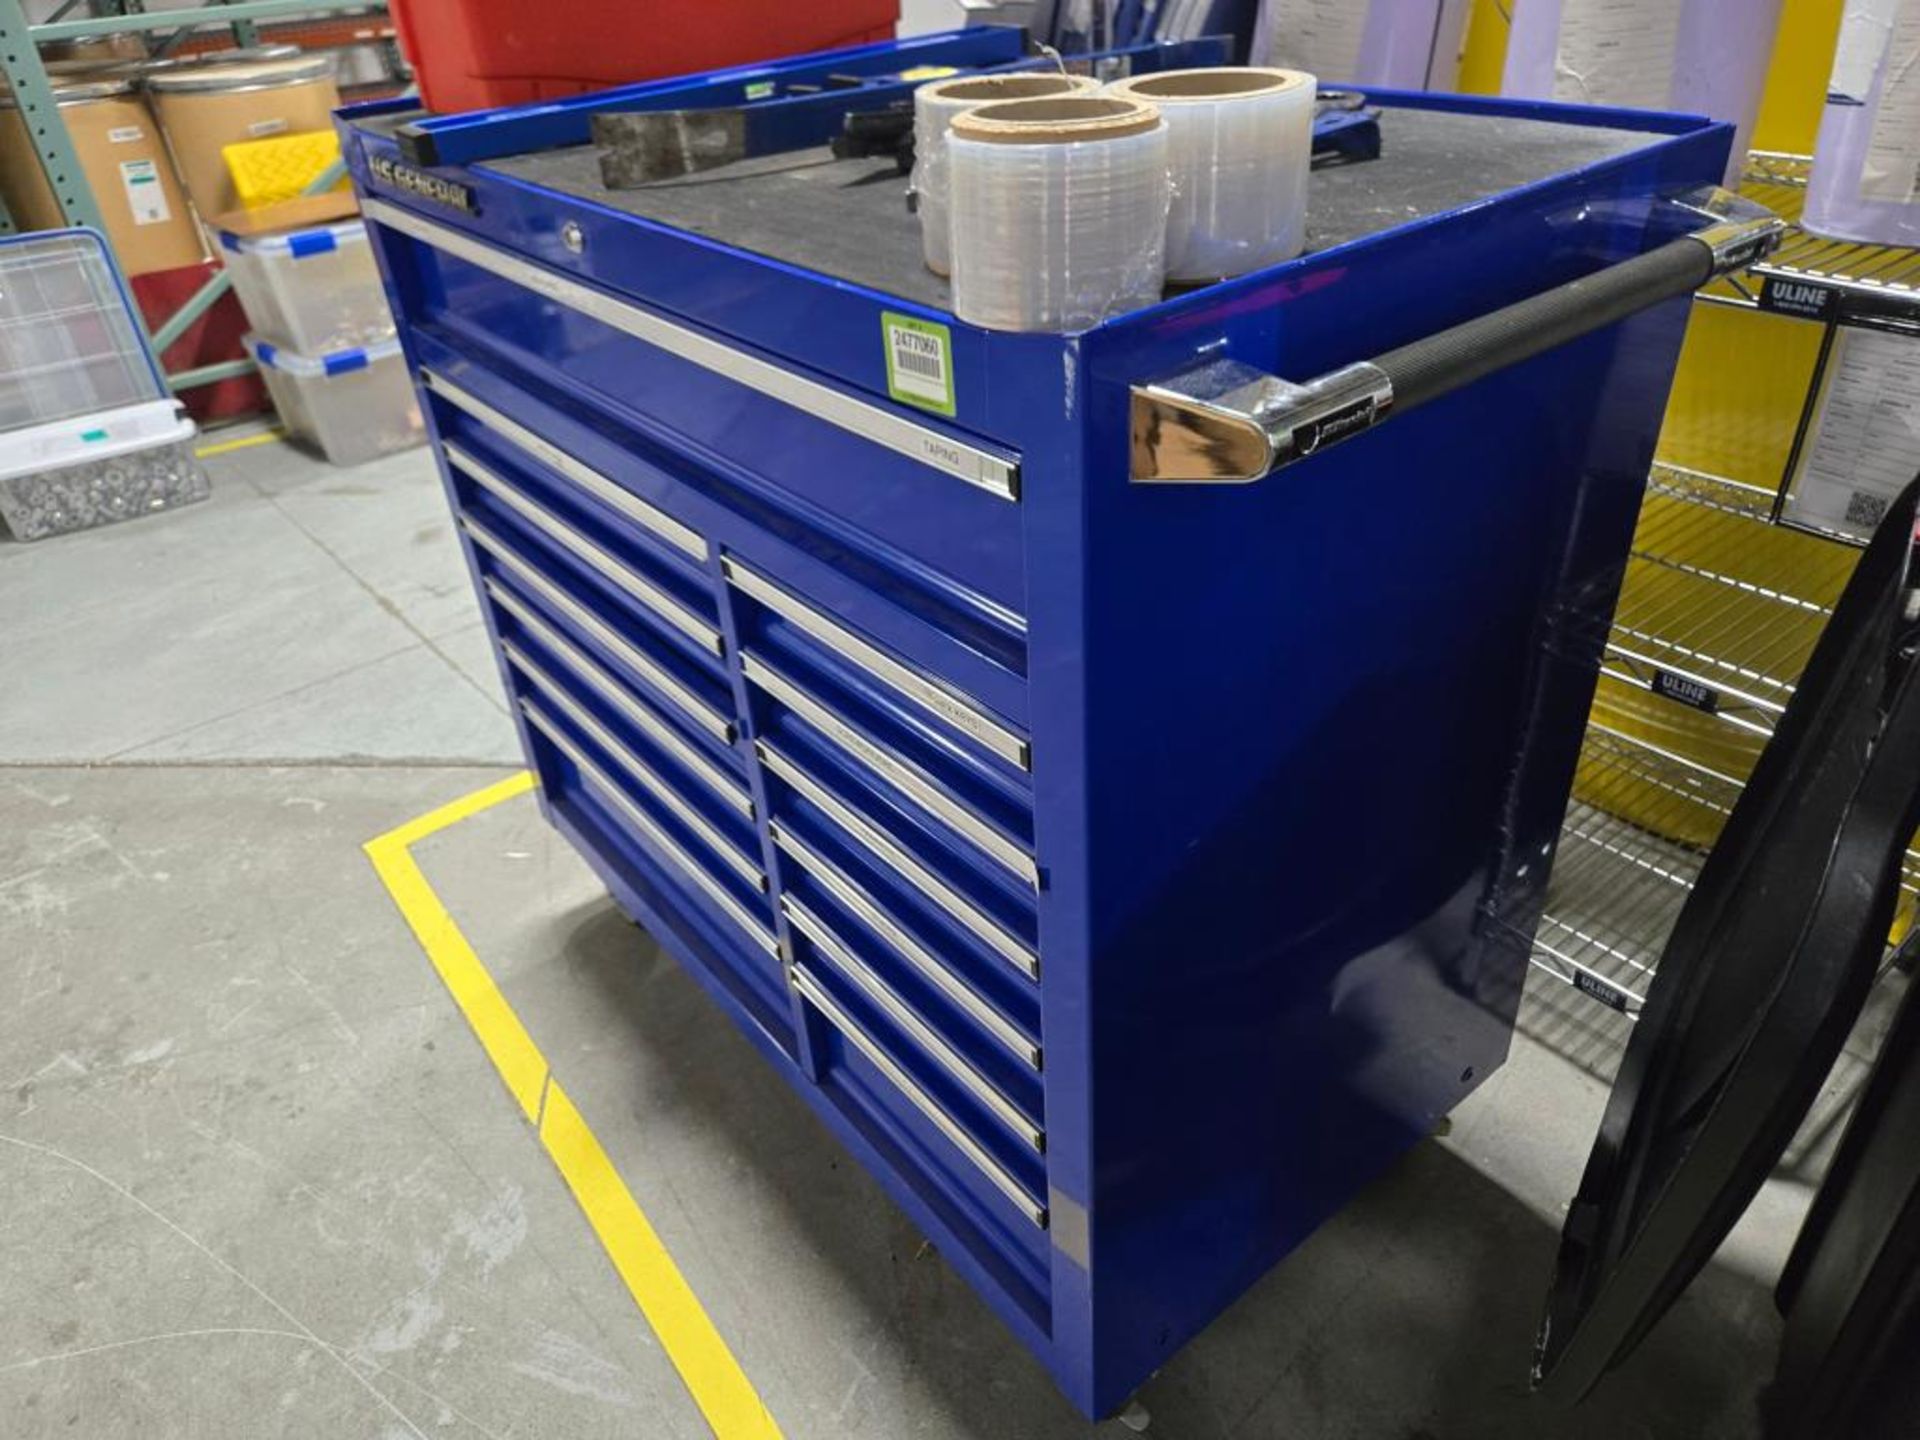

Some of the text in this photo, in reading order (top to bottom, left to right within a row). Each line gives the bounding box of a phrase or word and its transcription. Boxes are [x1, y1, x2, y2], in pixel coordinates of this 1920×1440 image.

[1772, 282, 1828, 306] ULINE
[894, 329, 940, 359] 2477060
[923, 439, 960, 466] TAPING
[1662, 674, 1708, 702] ULINE
